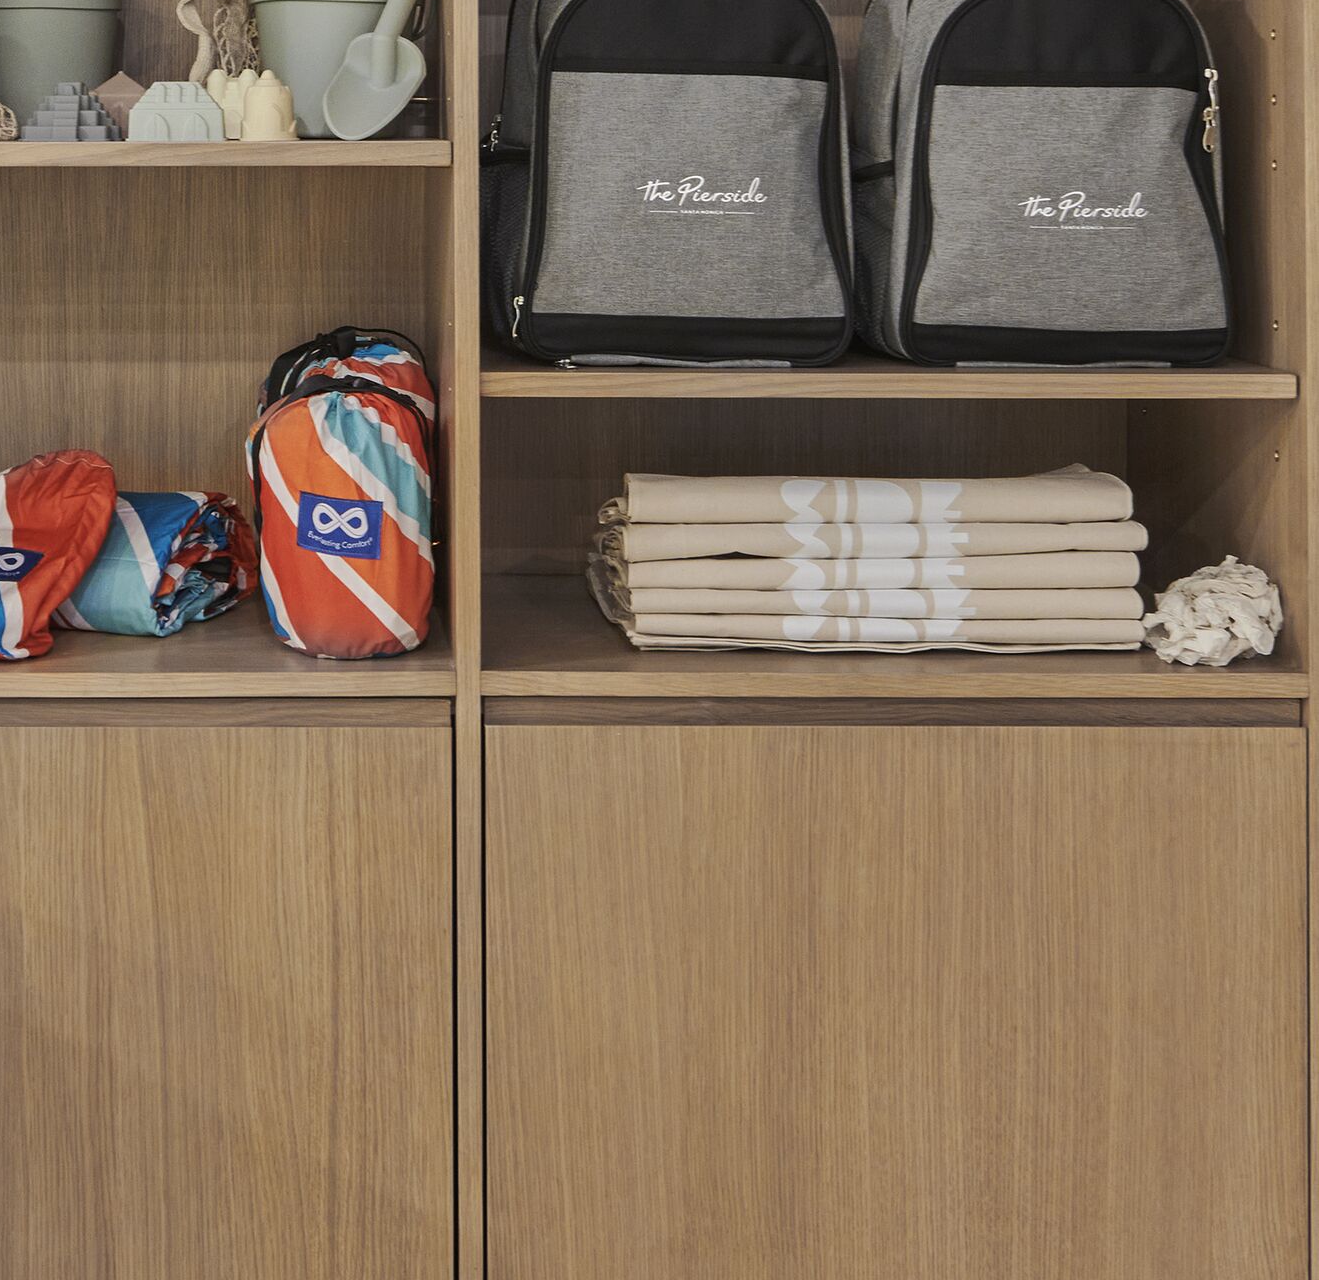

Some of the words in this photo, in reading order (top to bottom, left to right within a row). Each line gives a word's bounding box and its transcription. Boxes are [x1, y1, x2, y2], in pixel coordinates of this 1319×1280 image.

[636, 178, 676, 201] the
[677, 175, 768, 206] Pierside
[1018, 194, 1057, 217] the
[1057, 191, 1149, 222] Pierside
